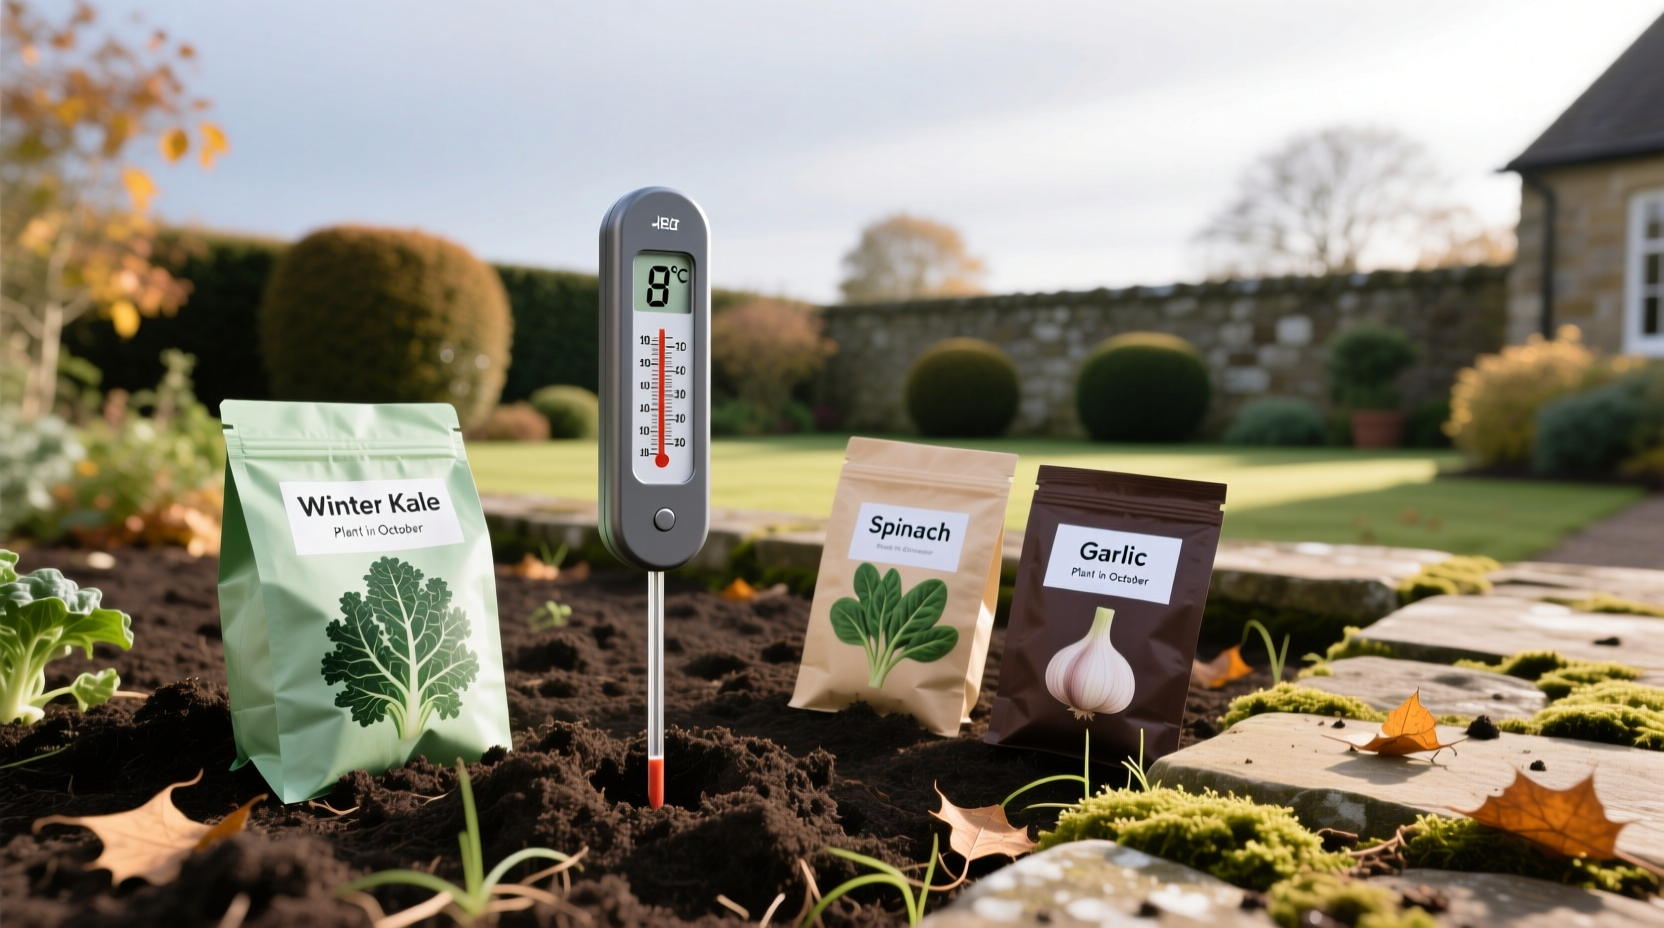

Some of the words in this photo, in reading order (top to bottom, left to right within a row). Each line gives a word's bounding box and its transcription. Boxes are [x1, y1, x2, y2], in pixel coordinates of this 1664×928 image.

[297, 495, 382, 517] Winter
[388, 491, 441, 514] Kale
[333, 525, 364, 538] Plant
[365, 525, 376, 536] in
[377, 523, 424, 536] October
[868, 515, 951, 542] Spinach
[1080, 541, 1148, 567] Garlic
[1071, 567, 1095, 579] Plant
